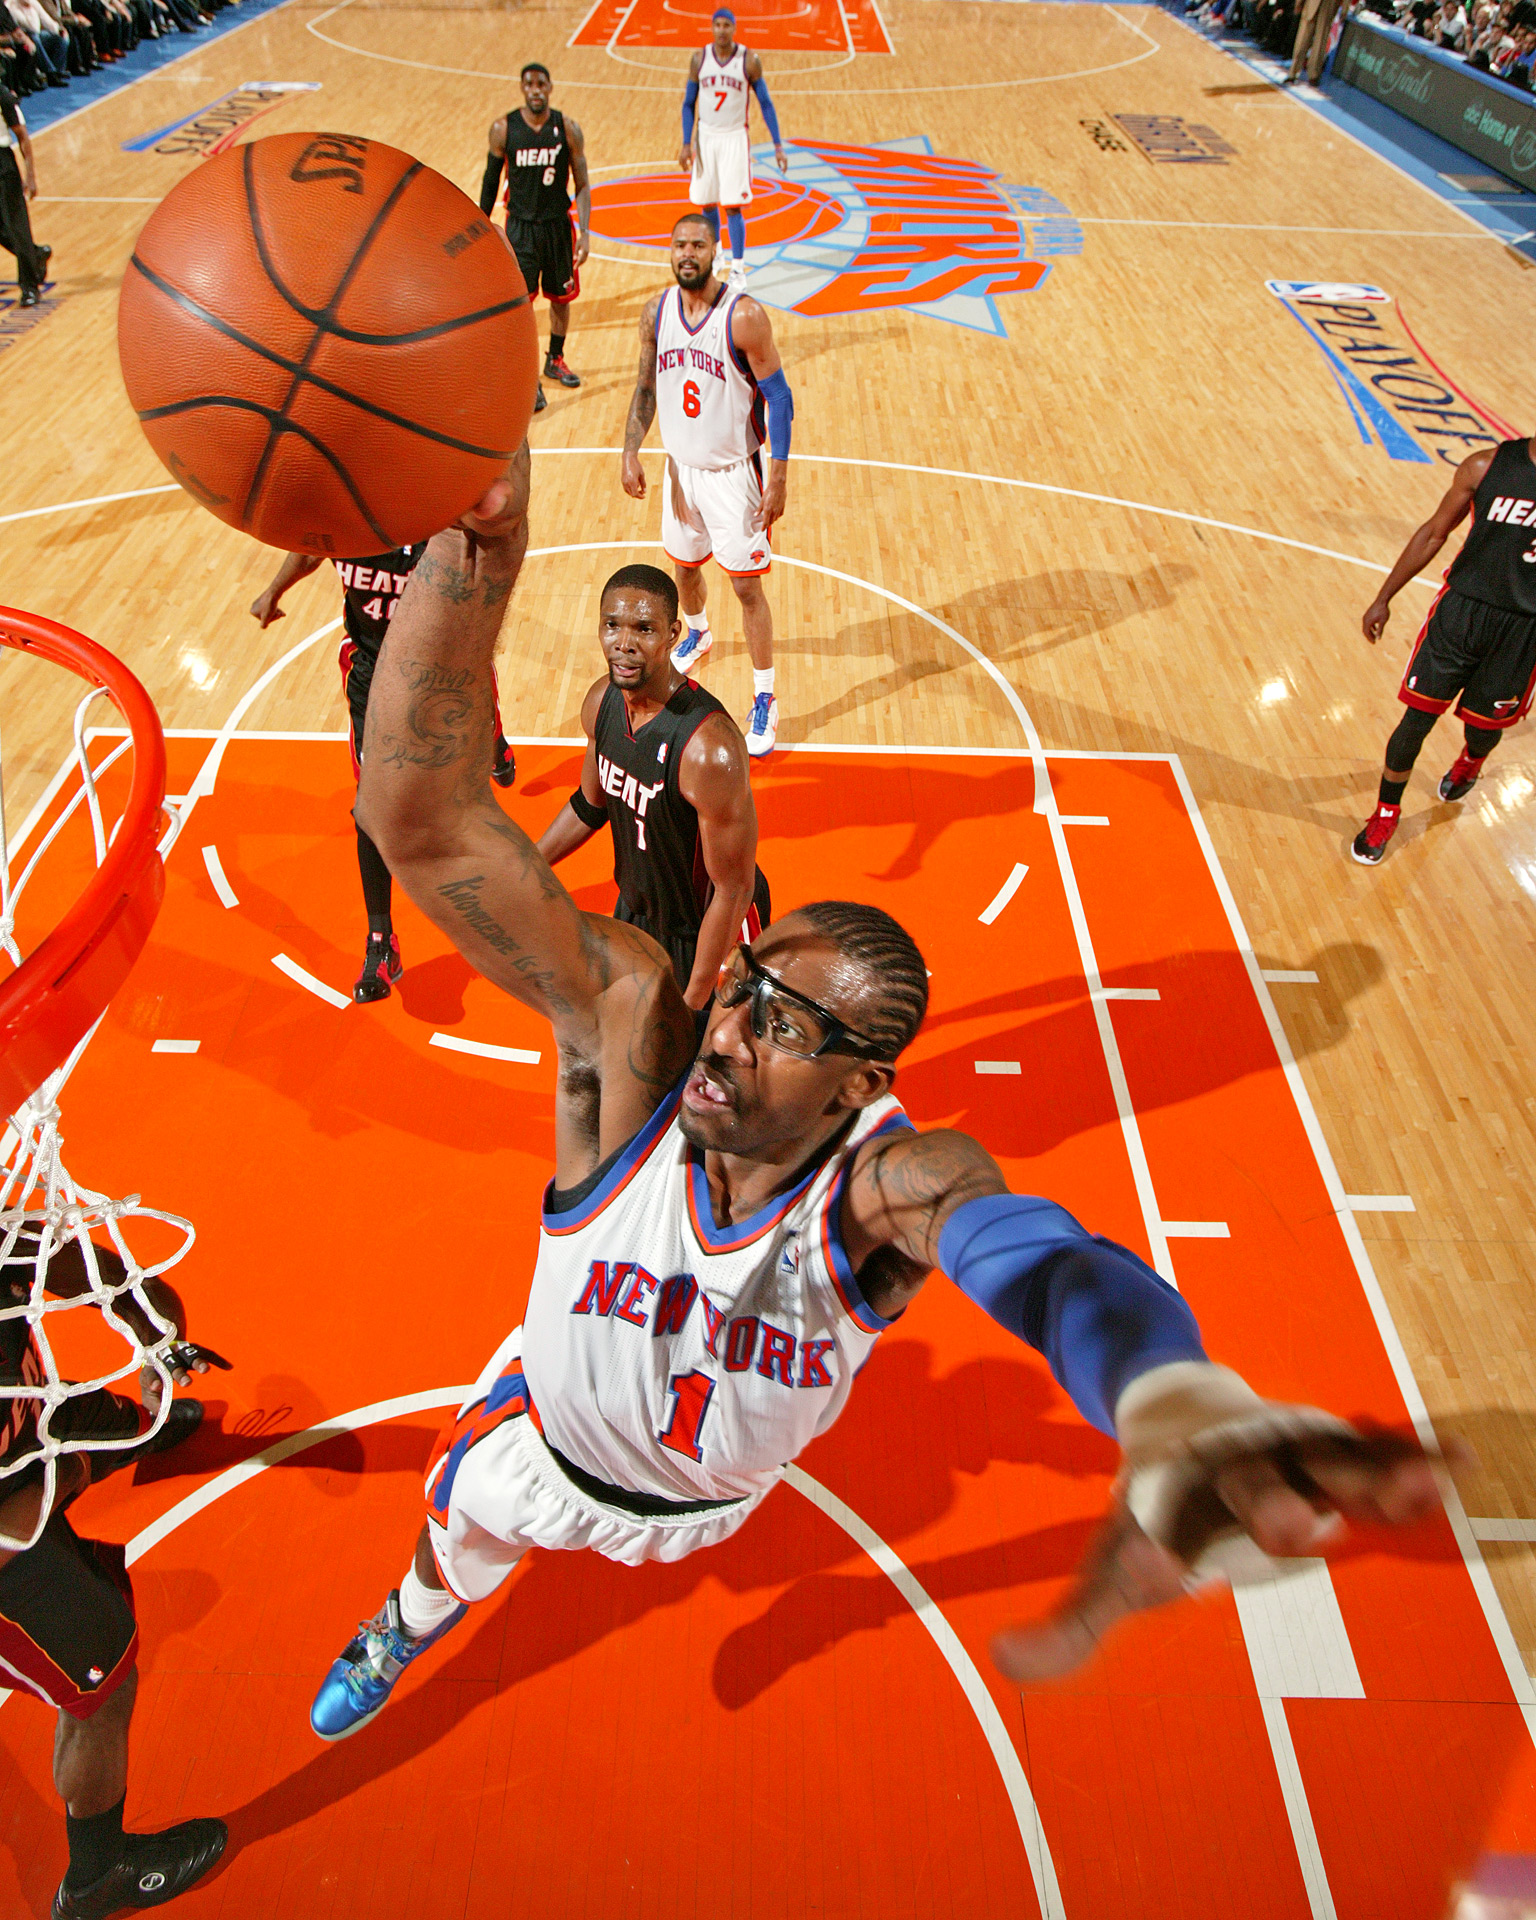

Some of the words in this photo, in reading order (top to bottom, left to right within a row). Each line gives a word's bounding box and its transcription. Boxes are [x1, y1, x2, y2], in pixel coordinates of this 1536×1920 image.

[714, 91, 728, 112] 7
[1478, 108, 1507, 142] Home
[1504, 124, 1521, 148] of
[515, 143, 562, 167] HEAT
[542, 167, 556, 187] 6
[786, 137, 1054, 318] KNICKS
[658, 348, 685, 374] NEW
[689, 347, 727, 383] YORK
[682, 378, 701, 419] 6
[336, 560, 413, 595] HEAT
[598, 752, 664, 817] HEAT
[634, 817, 647, 851] 1
[570, 1259, 701, 1338] NEW
[700, 1289, 835, 1388] YORK
[656, 1367, 717, 1464] 1
